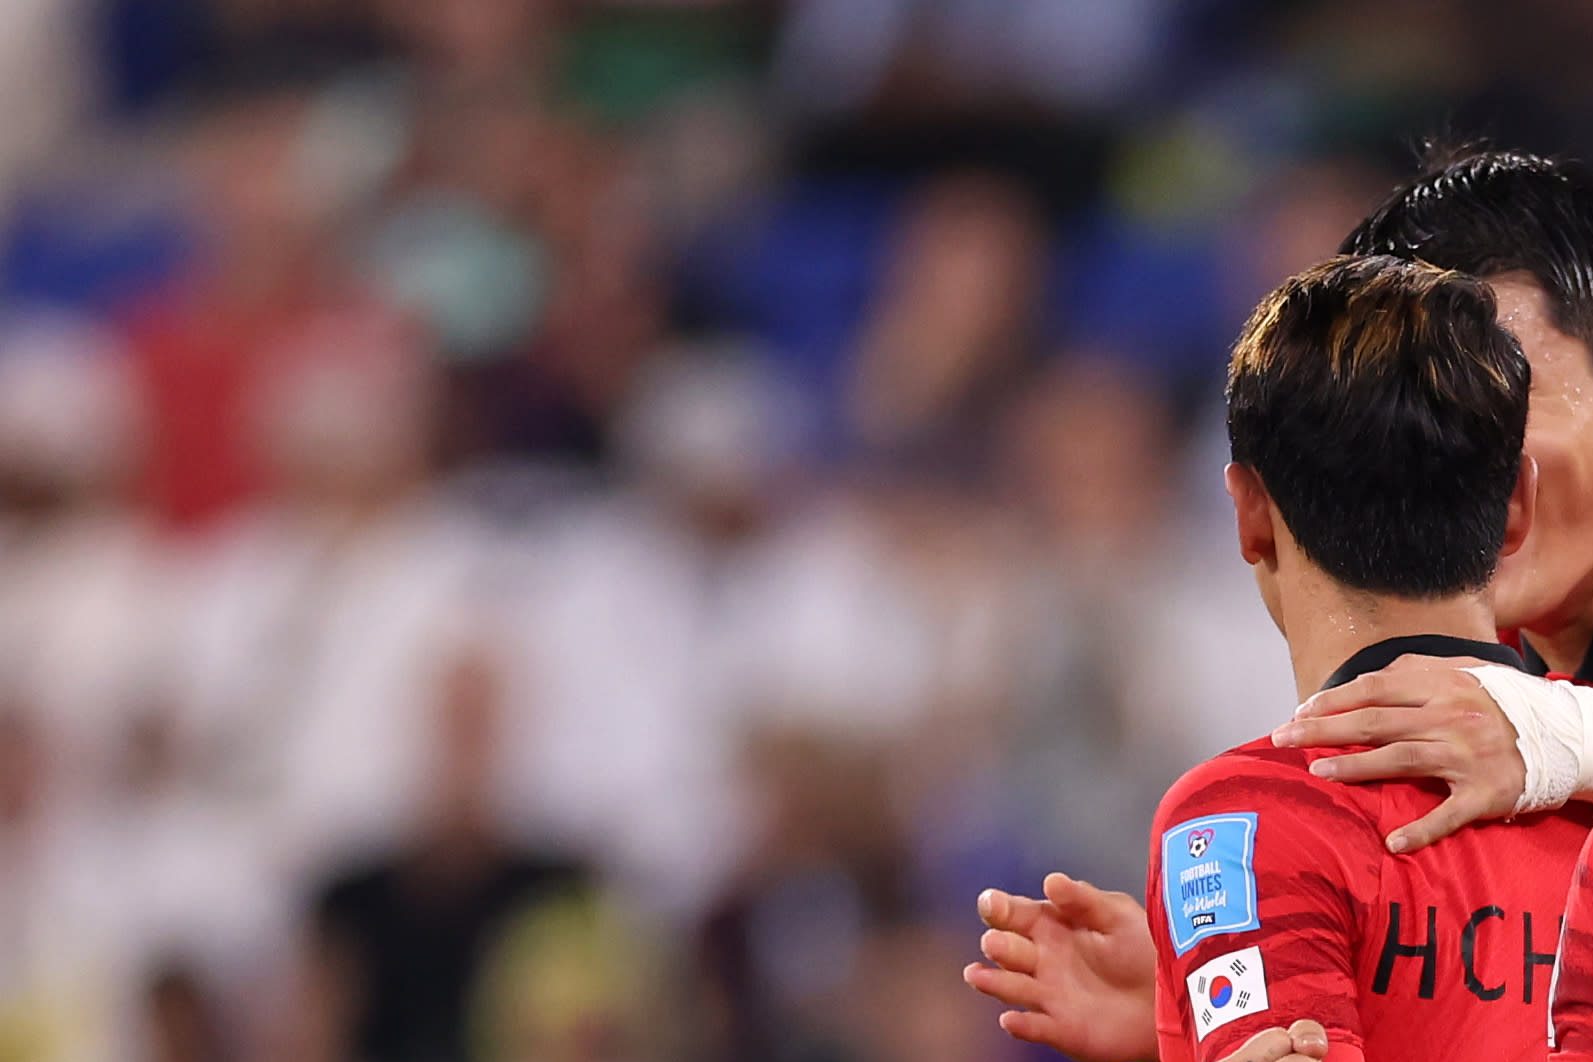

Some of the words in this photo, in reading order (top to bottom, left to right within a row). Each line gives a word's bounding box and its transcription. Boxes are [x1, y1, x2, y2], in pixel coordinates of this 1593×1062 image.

[1180, 860, 1222, 884] FOOTBALL
[1181, 873, 1222, 901] UNITES
[1193, 915, 1213, 927] FIFA
